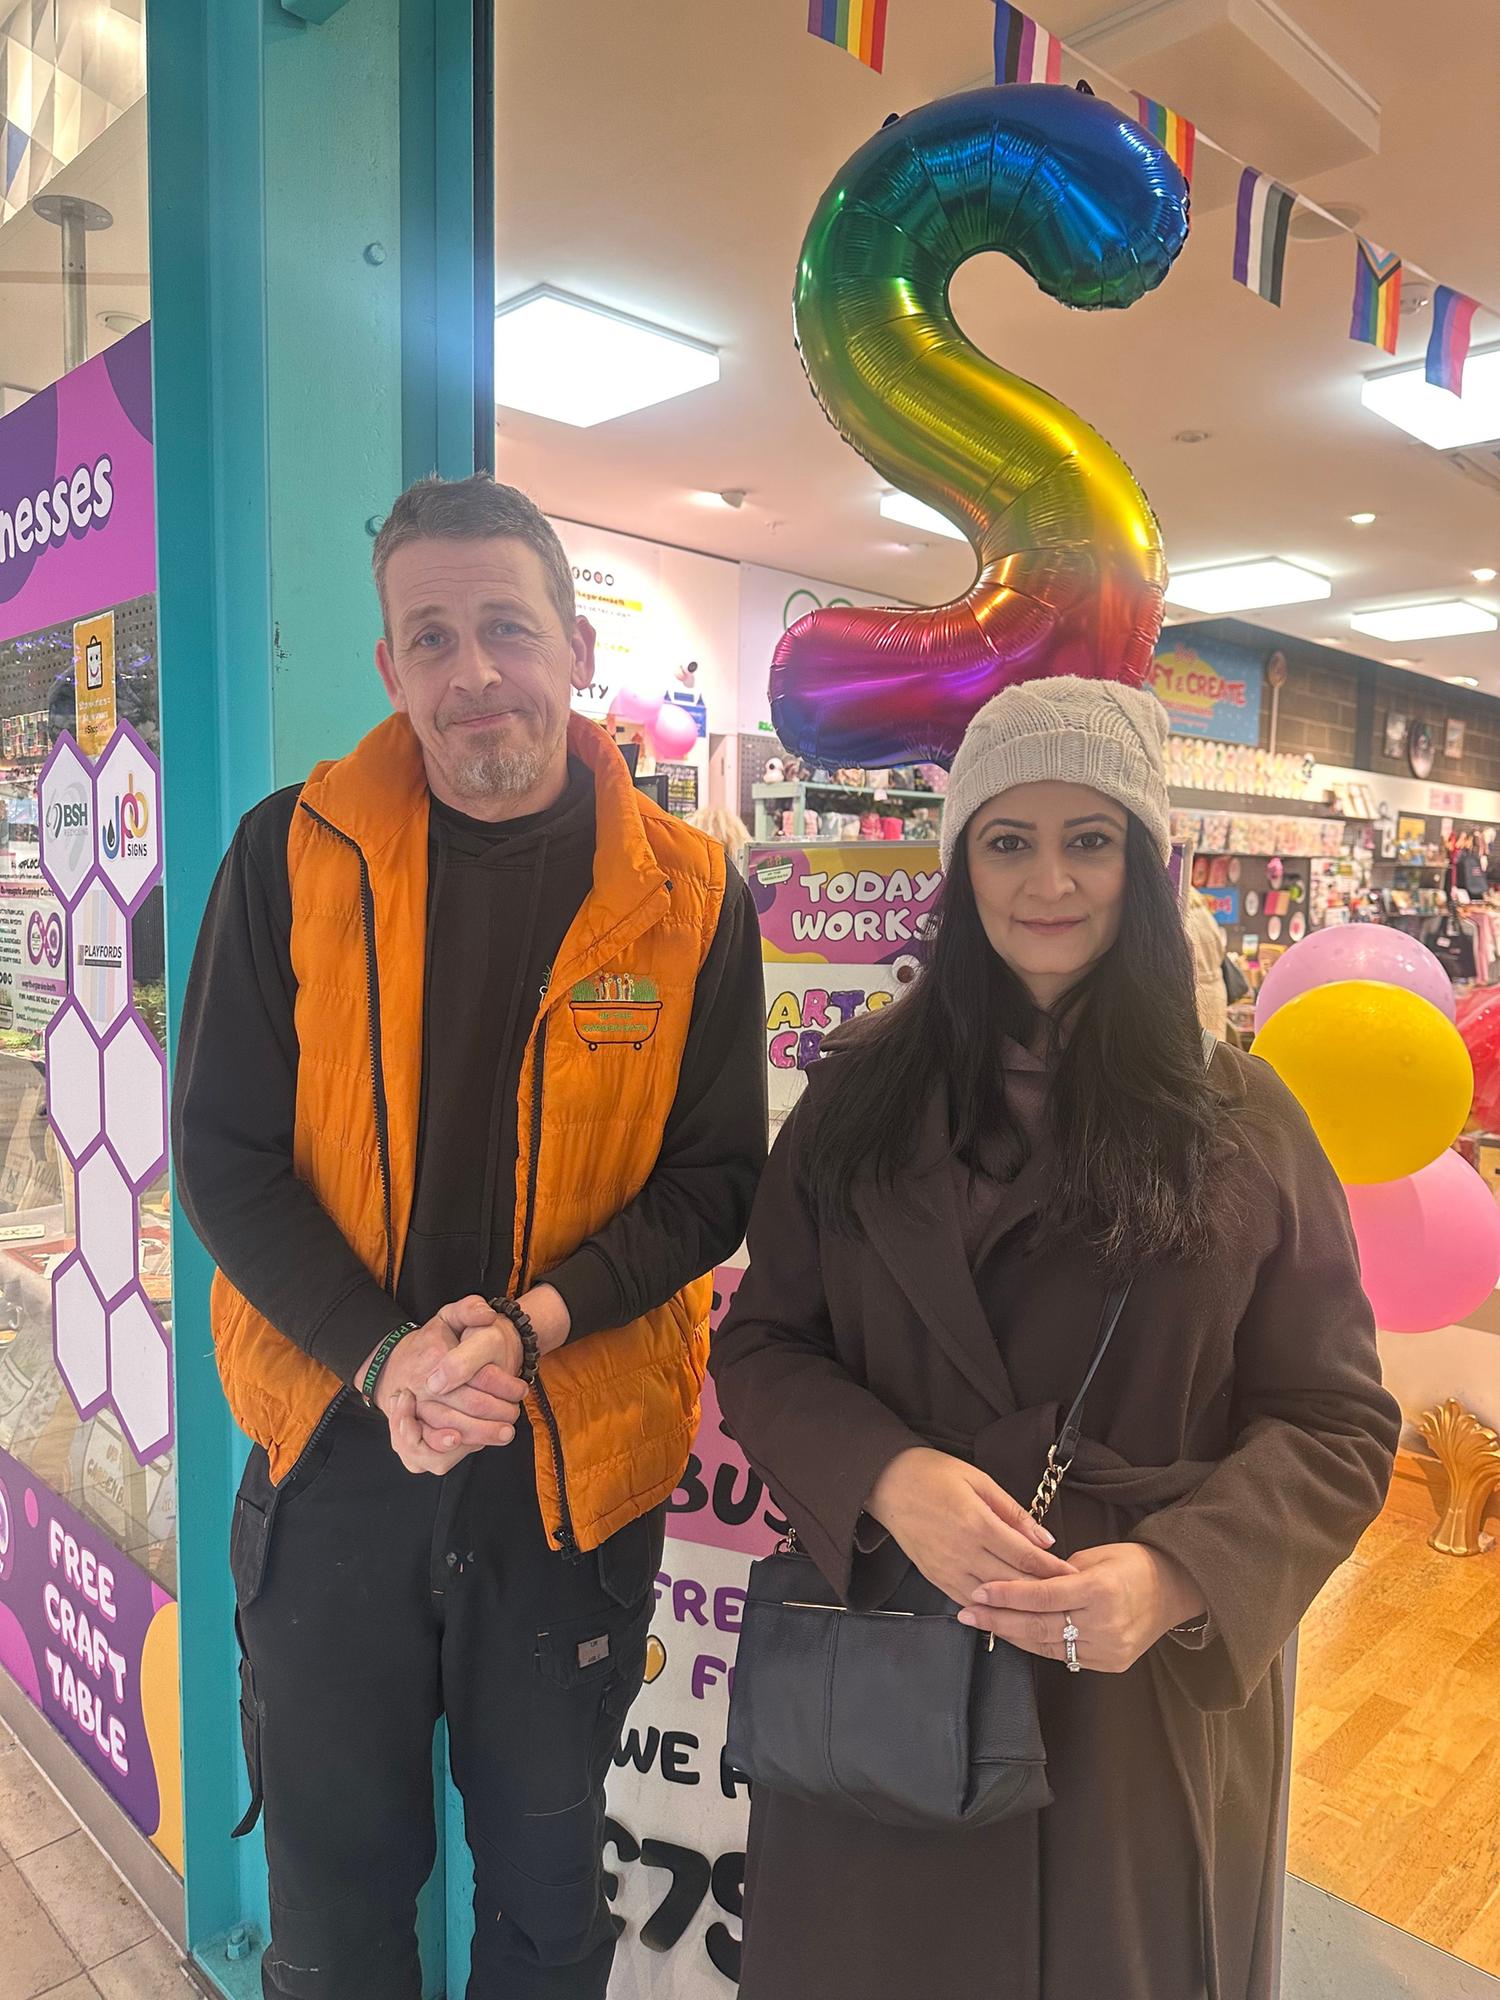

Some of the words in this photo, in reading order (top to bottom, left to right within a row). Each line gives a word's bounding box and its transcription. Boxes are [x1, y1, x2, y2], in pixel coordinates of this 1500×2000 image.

[1186, 672, 1247, 707] CREATE
[63, 803, 88, 827] BSH
[127, 843, 148, 857] SIGNS
[799, 869, 943, 903] TODAY
[791, 908, 939, 942] WORKS
[85, 944, 123, 960] PLAYFORDS
[766, 989, 894, 1030] ARTS
[363, 1325, 409, 1394] PALESTINE
[50, 1518, 116, 1620] FREE
[45, 1583, 127, 1701] CRAFT
[691, 1654, 736, 1700] F
[46, 1648, 129, 1774] TABLE
[613, 1726, 701, 1785] WE
